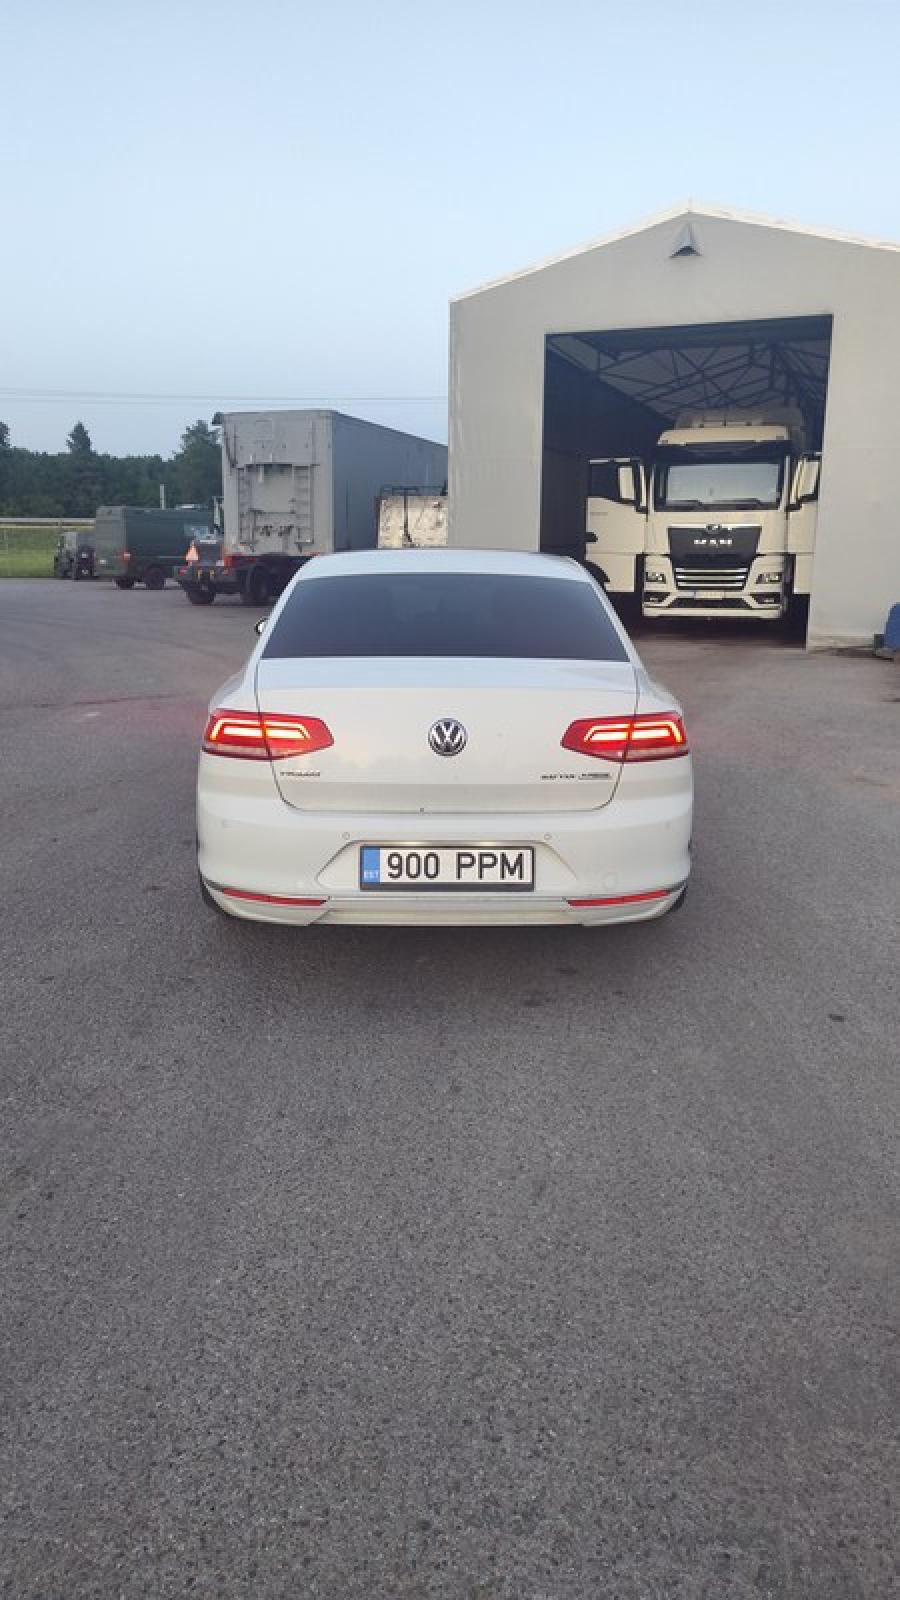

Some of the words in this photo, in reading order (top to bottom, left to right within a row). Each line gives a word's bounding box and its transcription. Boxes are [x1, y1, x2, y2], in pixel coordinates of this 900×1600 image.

[429, 718, 467, 757] VW
[387, 852, 440, 880] 900
[455, 852, 524, 880] PPM
